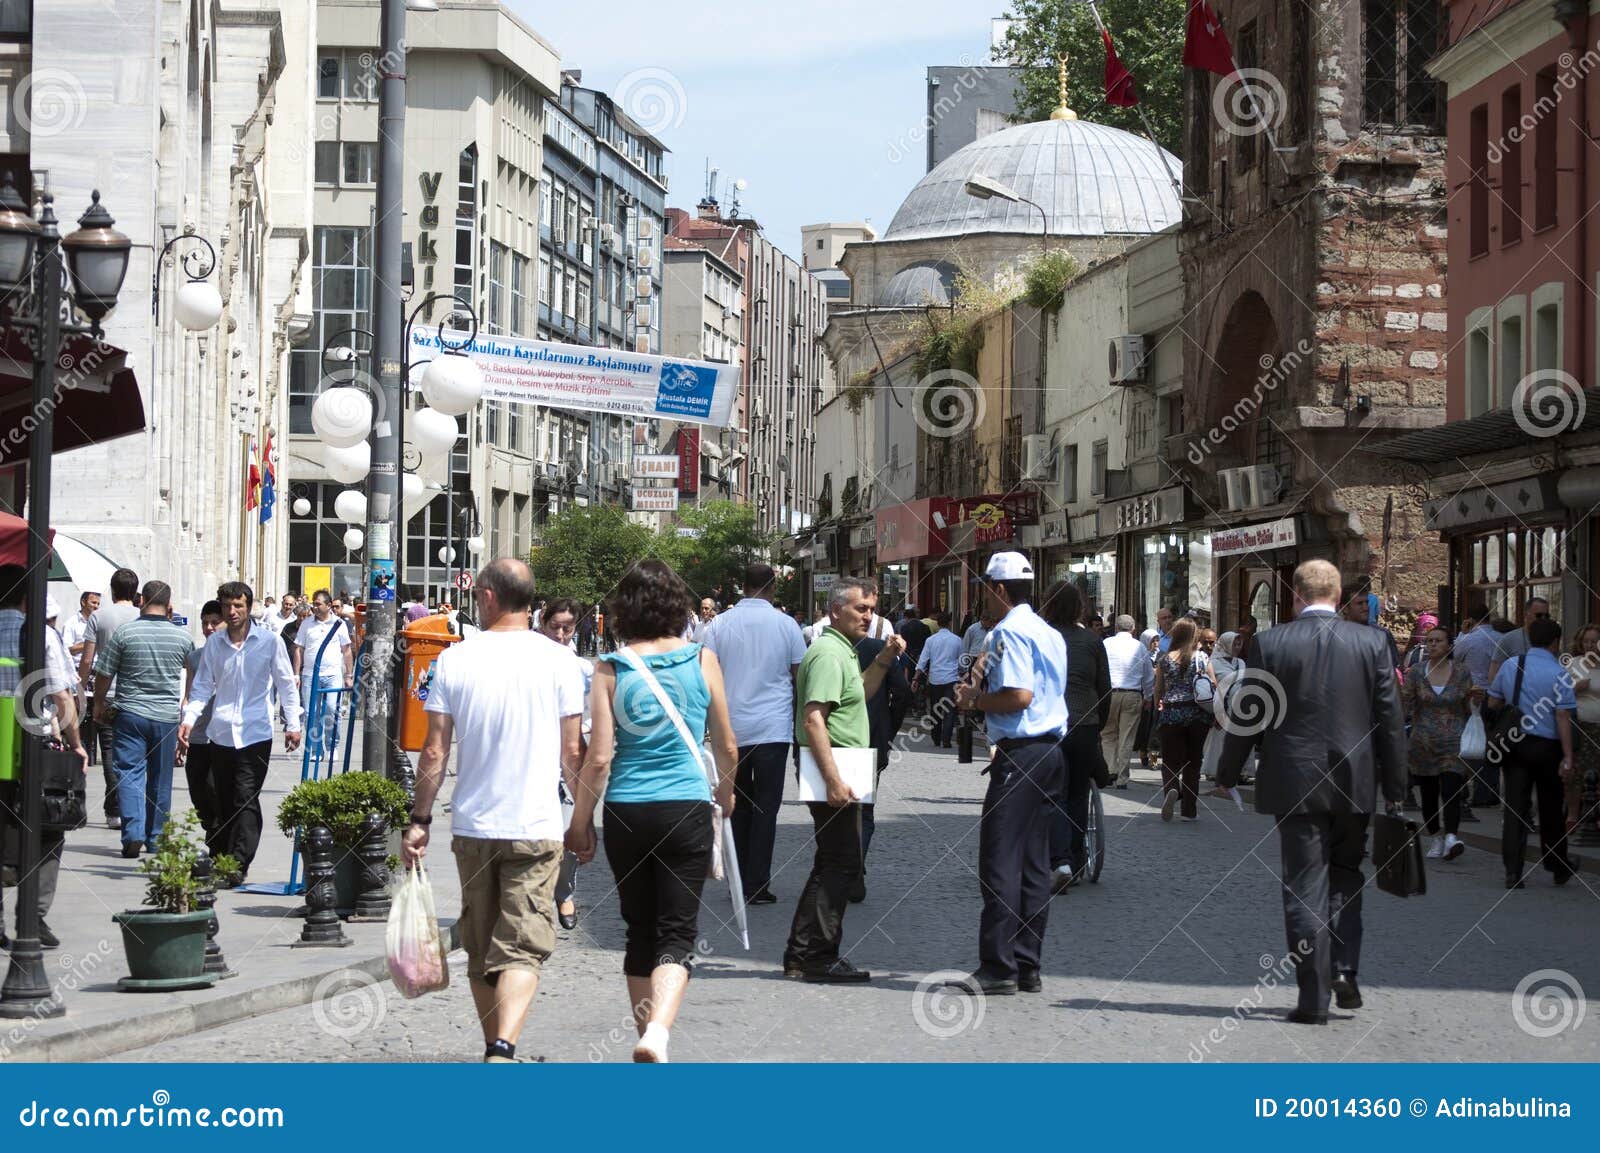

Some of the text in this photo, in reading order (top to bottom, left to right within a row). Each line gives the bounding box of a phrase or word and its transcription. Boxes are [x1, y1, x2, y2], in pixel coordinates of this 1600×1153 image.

[464, 338, 511, 357] Okulları
[514, 345, 584, 365] Kayıtlarımız
[587, 355, 653, 374] Başlamıştır
